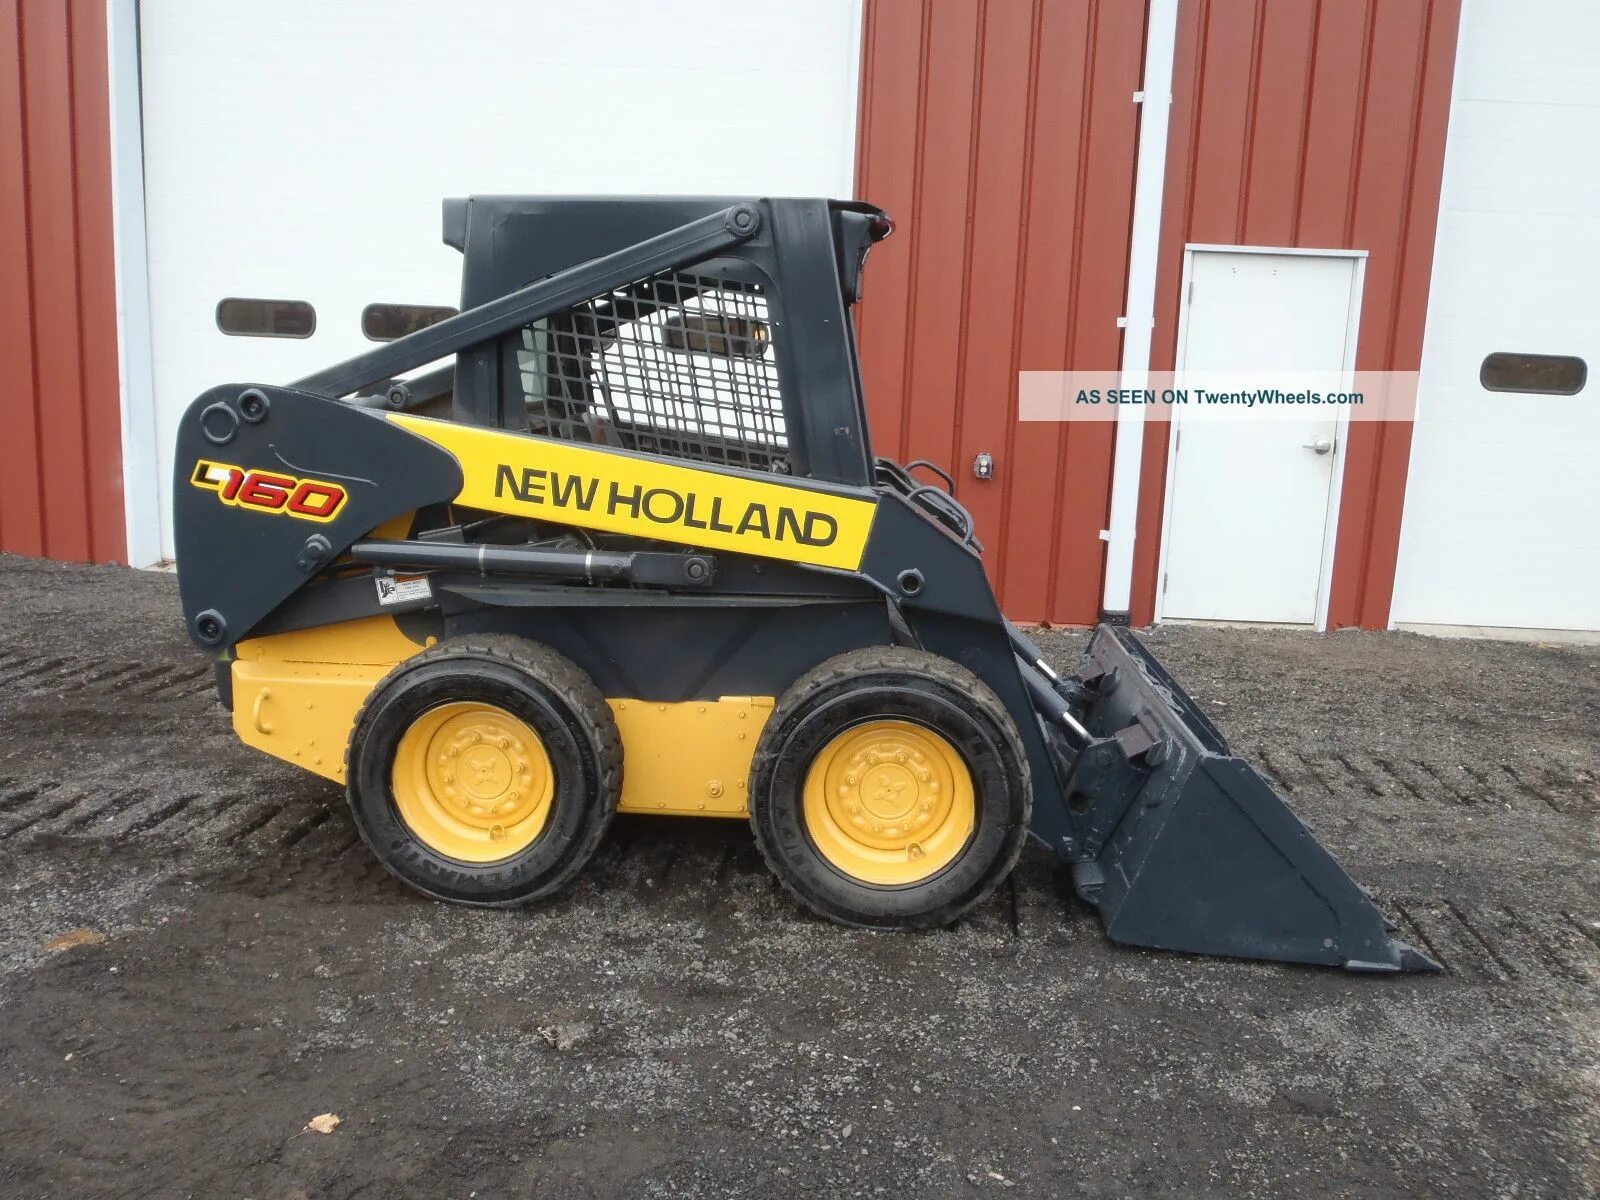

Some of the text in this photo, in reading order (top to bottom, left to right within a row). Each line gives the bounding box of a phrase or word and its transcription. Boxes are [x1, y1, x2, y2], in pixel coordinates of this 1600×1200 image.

[192, 461, 347, 520] L160
[494, 463, 839, 548] NEW HOLLAND
